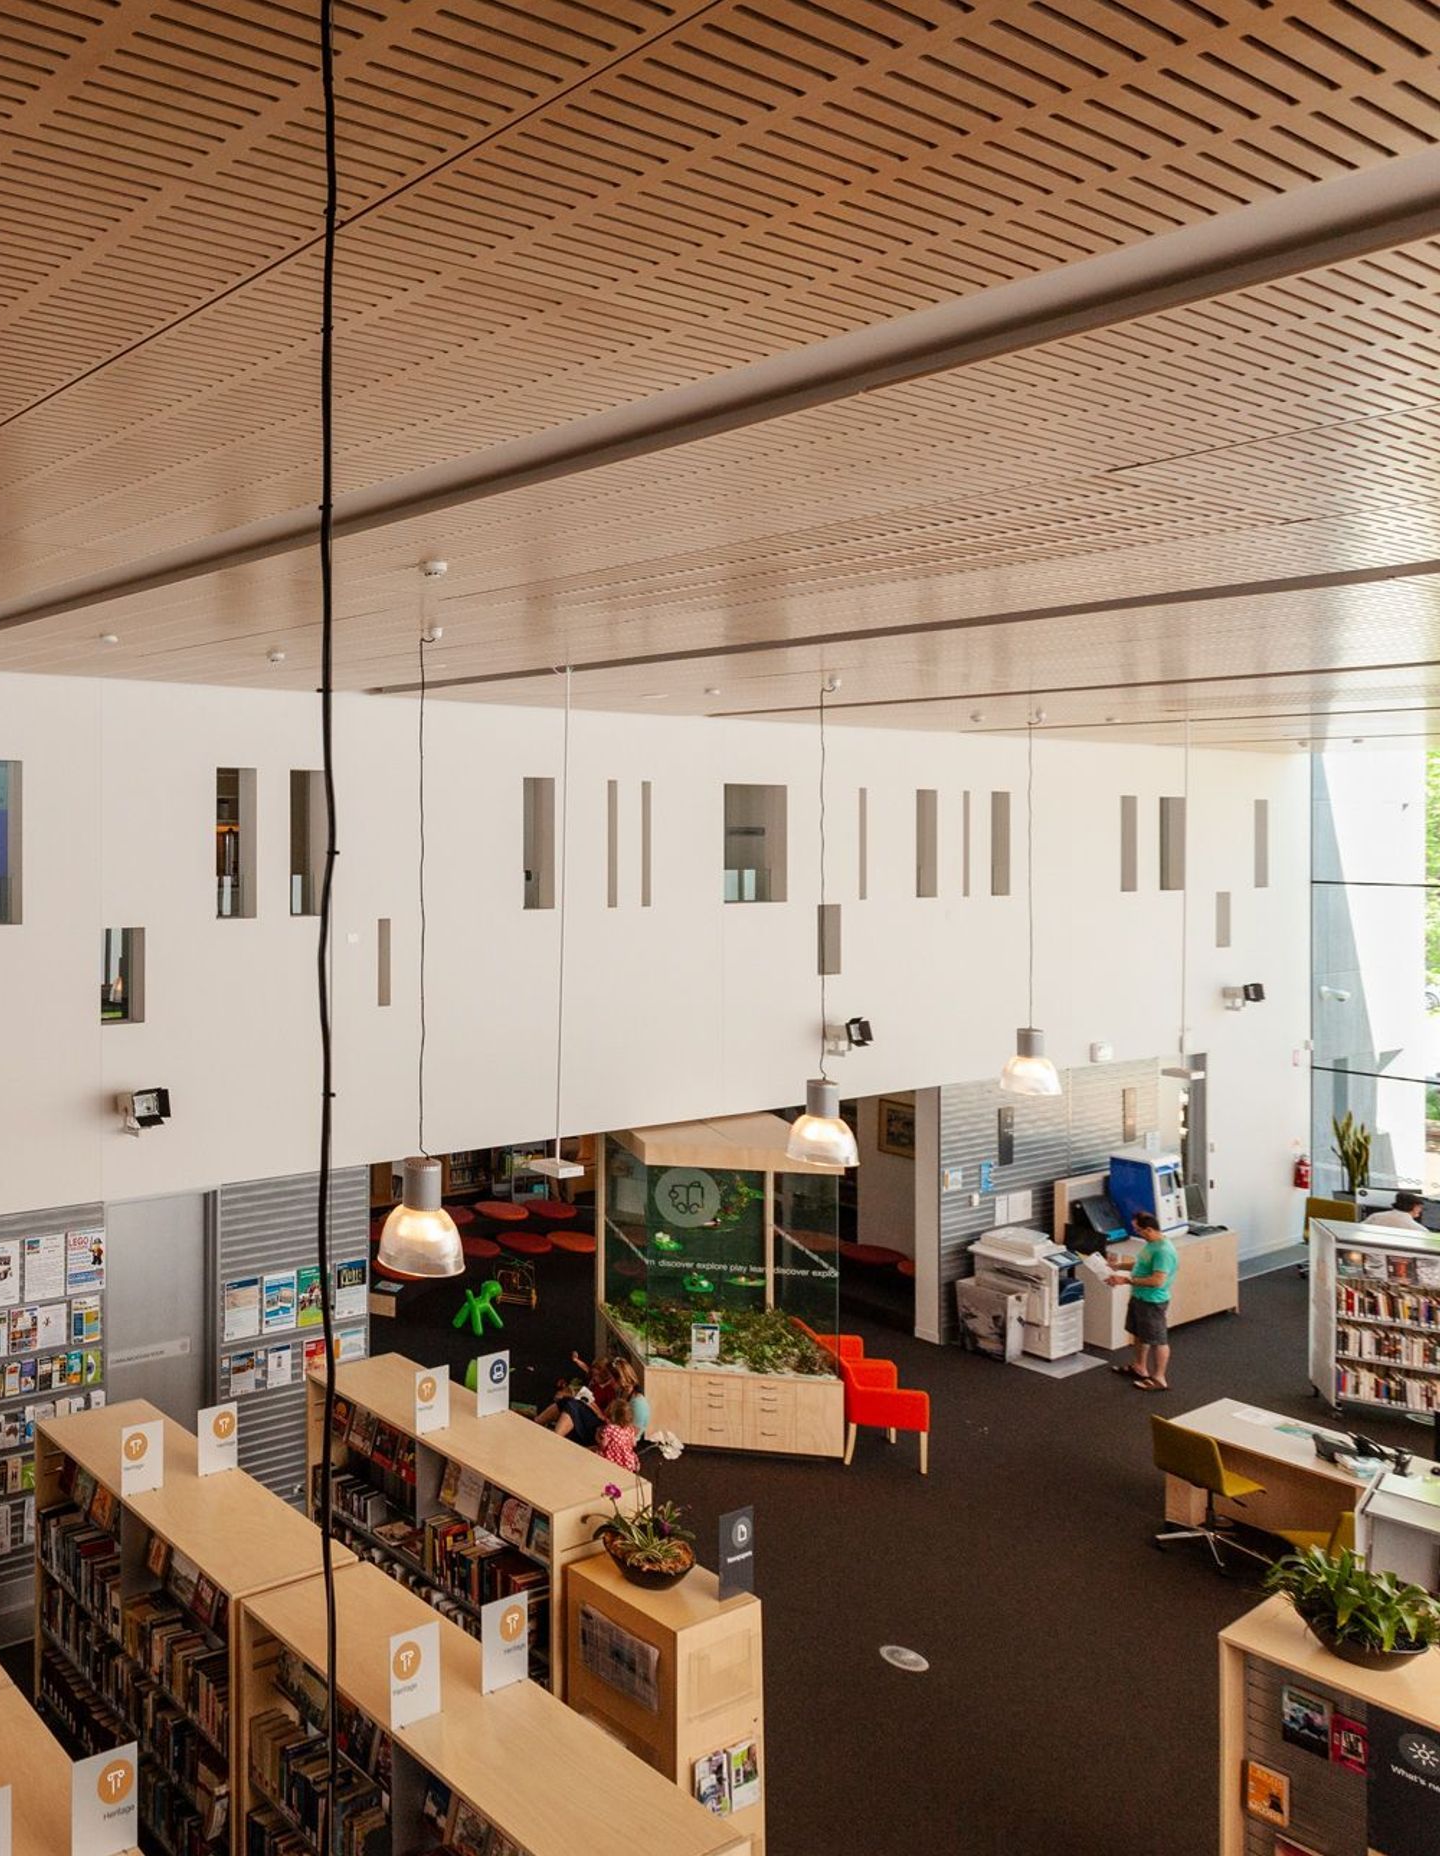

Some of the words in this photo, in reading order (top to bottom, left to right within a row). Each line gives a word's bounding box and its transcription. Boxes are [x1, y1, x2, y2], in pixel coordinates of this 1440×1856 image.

[658, 1260, 695, 1268] discover
[696, 1262, 728, 1271] explore
[729, 1264, 748, 1274] play
[1390, 1764, 1426, 1786] What's
[1428, 1782, 1440, 1794] ne
[104, 1804, 135, 1820] Heritage
